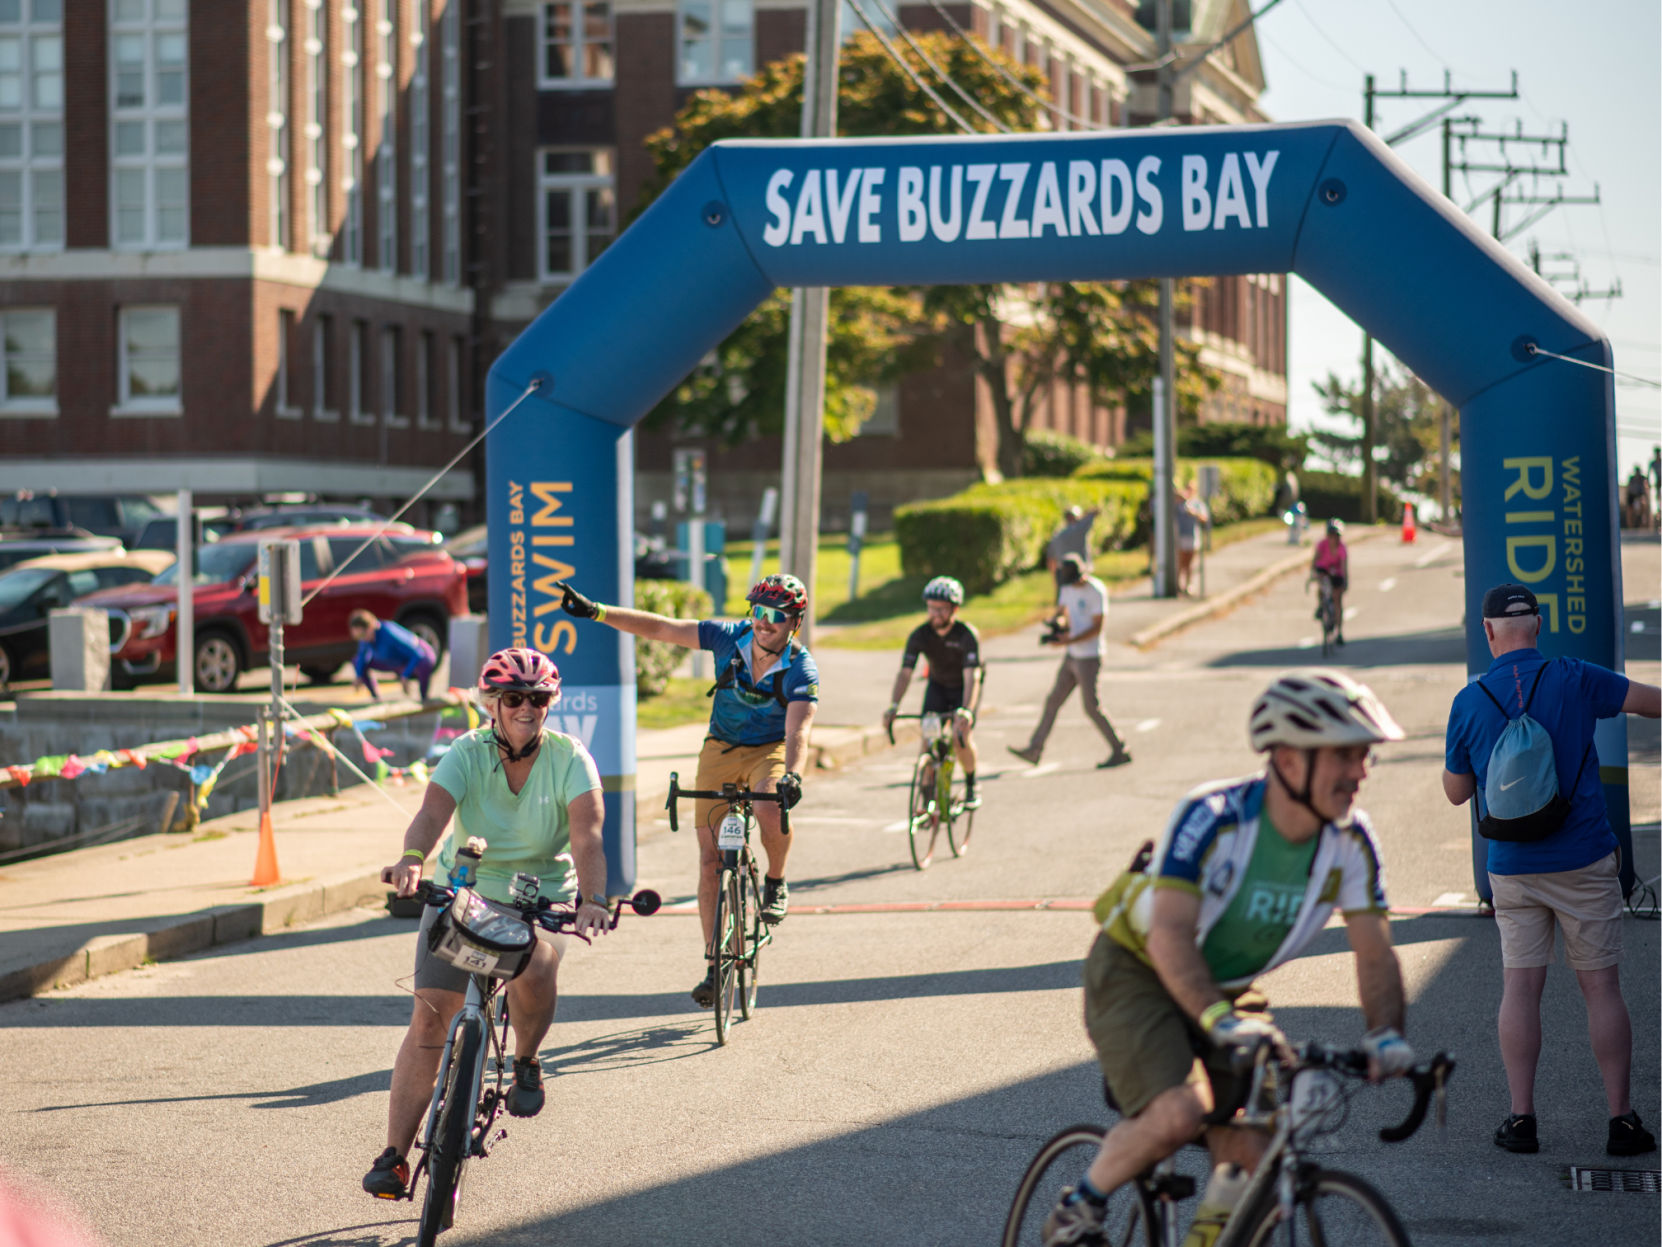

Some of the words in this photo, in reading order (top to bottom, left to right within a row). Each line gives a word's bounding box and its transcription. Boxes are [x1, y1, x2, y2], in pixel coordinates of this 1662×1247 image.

[763, 167, 886, 247] SAVE
[898, 155, 1164, 243] BUZZARDS
[1182, 150, 1280, 231] BAY
[509, 480, 525, 525] BAY
[1561, 456, 1586, 634] WATERSHED
[510, 530, 527, 649] BUZZARDS
[530, 482, 577, 655] SWIM
[723, 826, 741, 835] 146
[465, 955, 487, 968] 141
